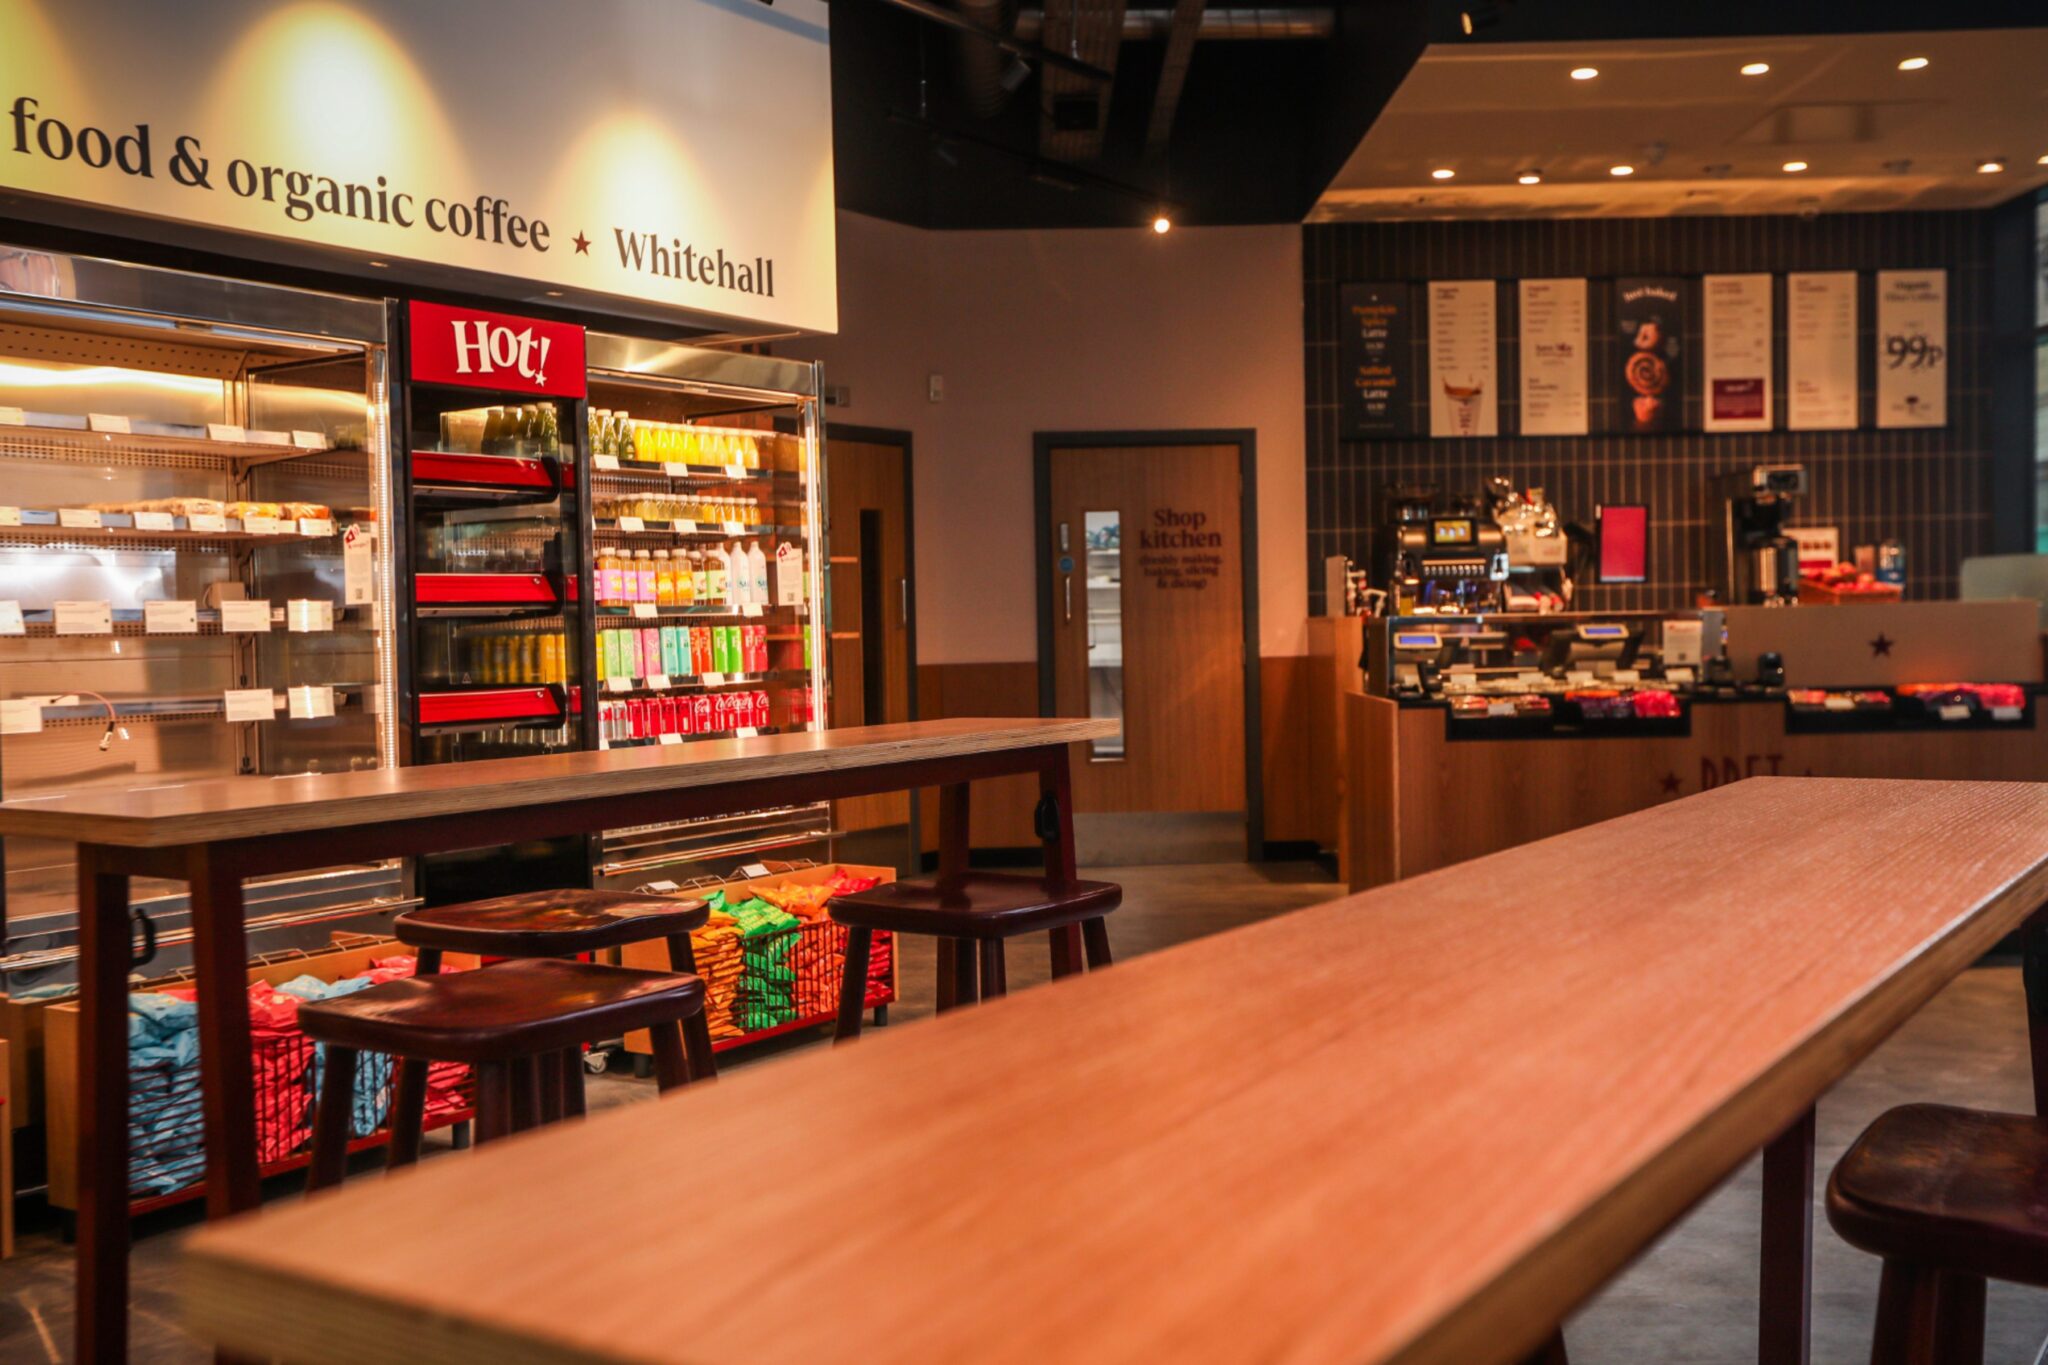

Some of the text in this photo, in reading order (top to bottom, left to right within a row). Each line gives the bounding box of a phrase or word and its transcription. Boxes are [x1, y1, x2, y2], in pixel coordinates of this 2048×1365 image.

[8, 97, 776, 298] food & organic coffee Whitehall
[451, 320, 551, 388] Hot!
[1886, 335, 1945, 370] 99p
[1153, 508, 1207, 532] Shop
[1139, 529, 1222, 549] kitchen
